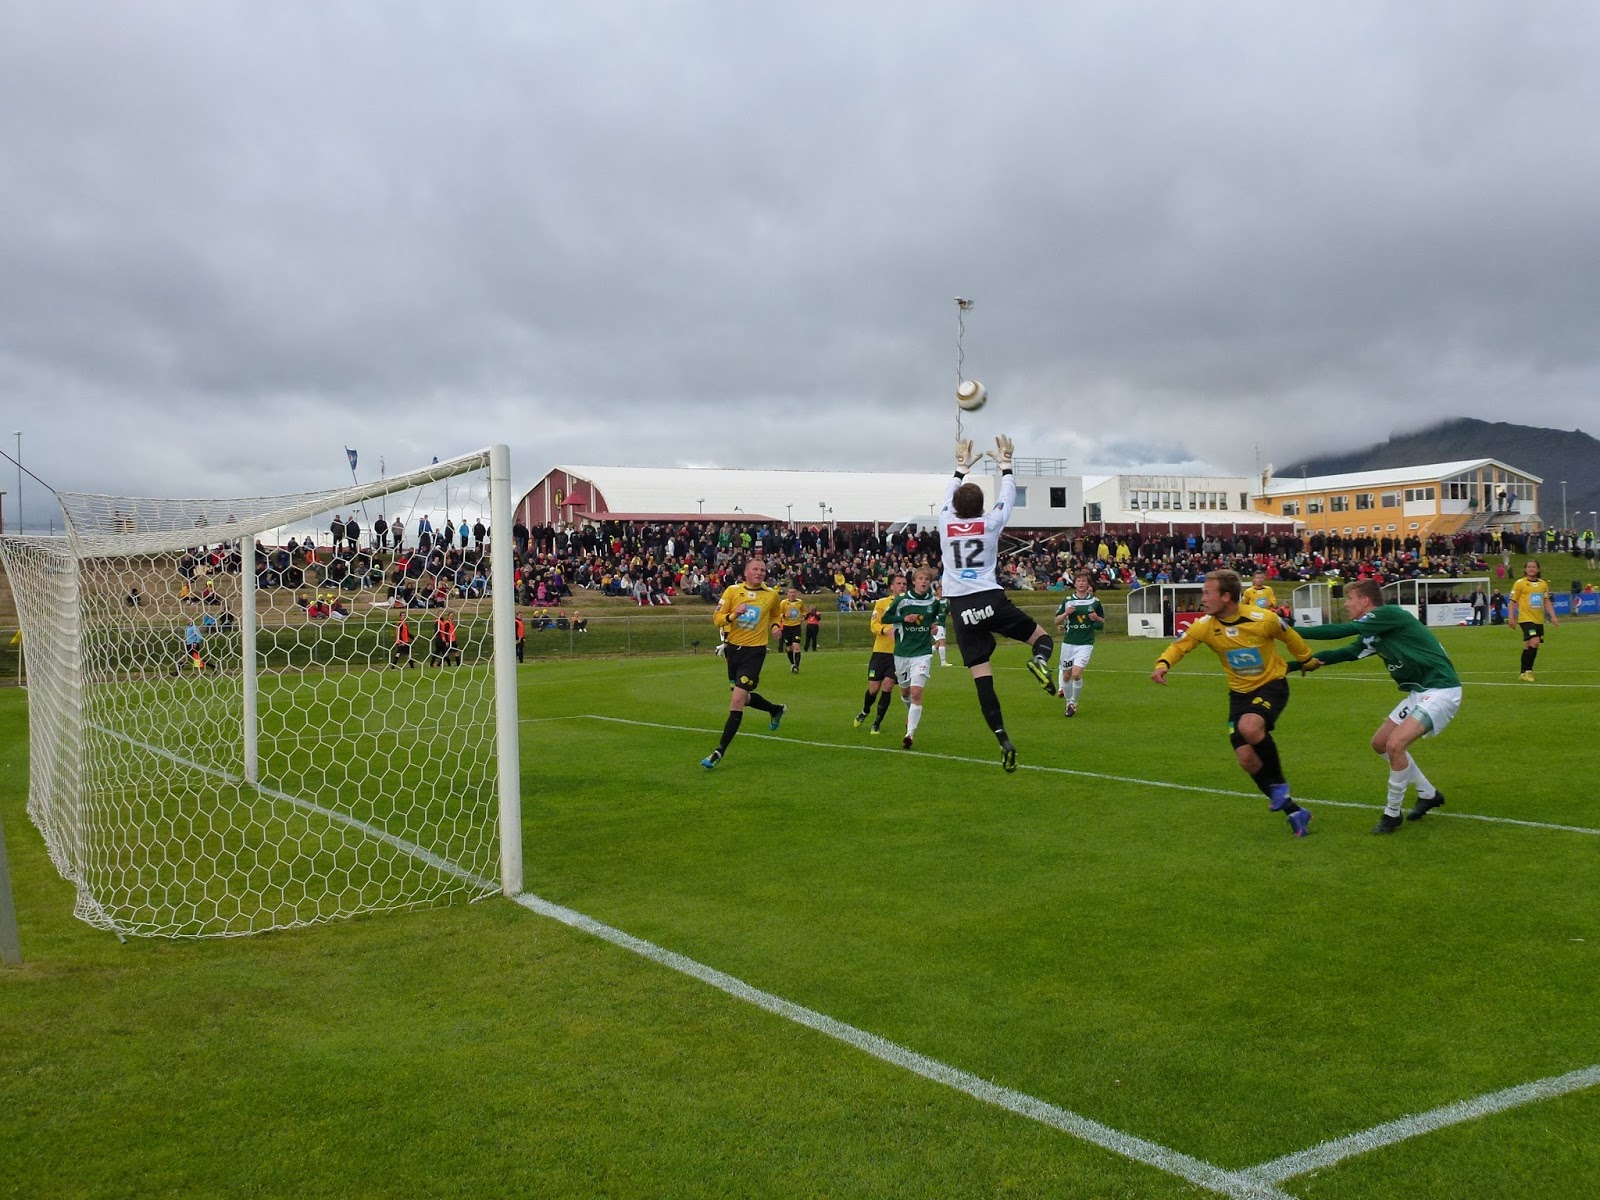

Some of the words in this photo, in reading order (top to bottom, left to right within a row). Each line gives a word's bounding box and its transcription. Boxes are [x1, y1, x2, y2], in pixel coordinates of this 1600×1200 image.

[950, 538, 985, 568] 12
[902, 671, 908, 681] 7
[1399, 705, 1411, 719] 5
